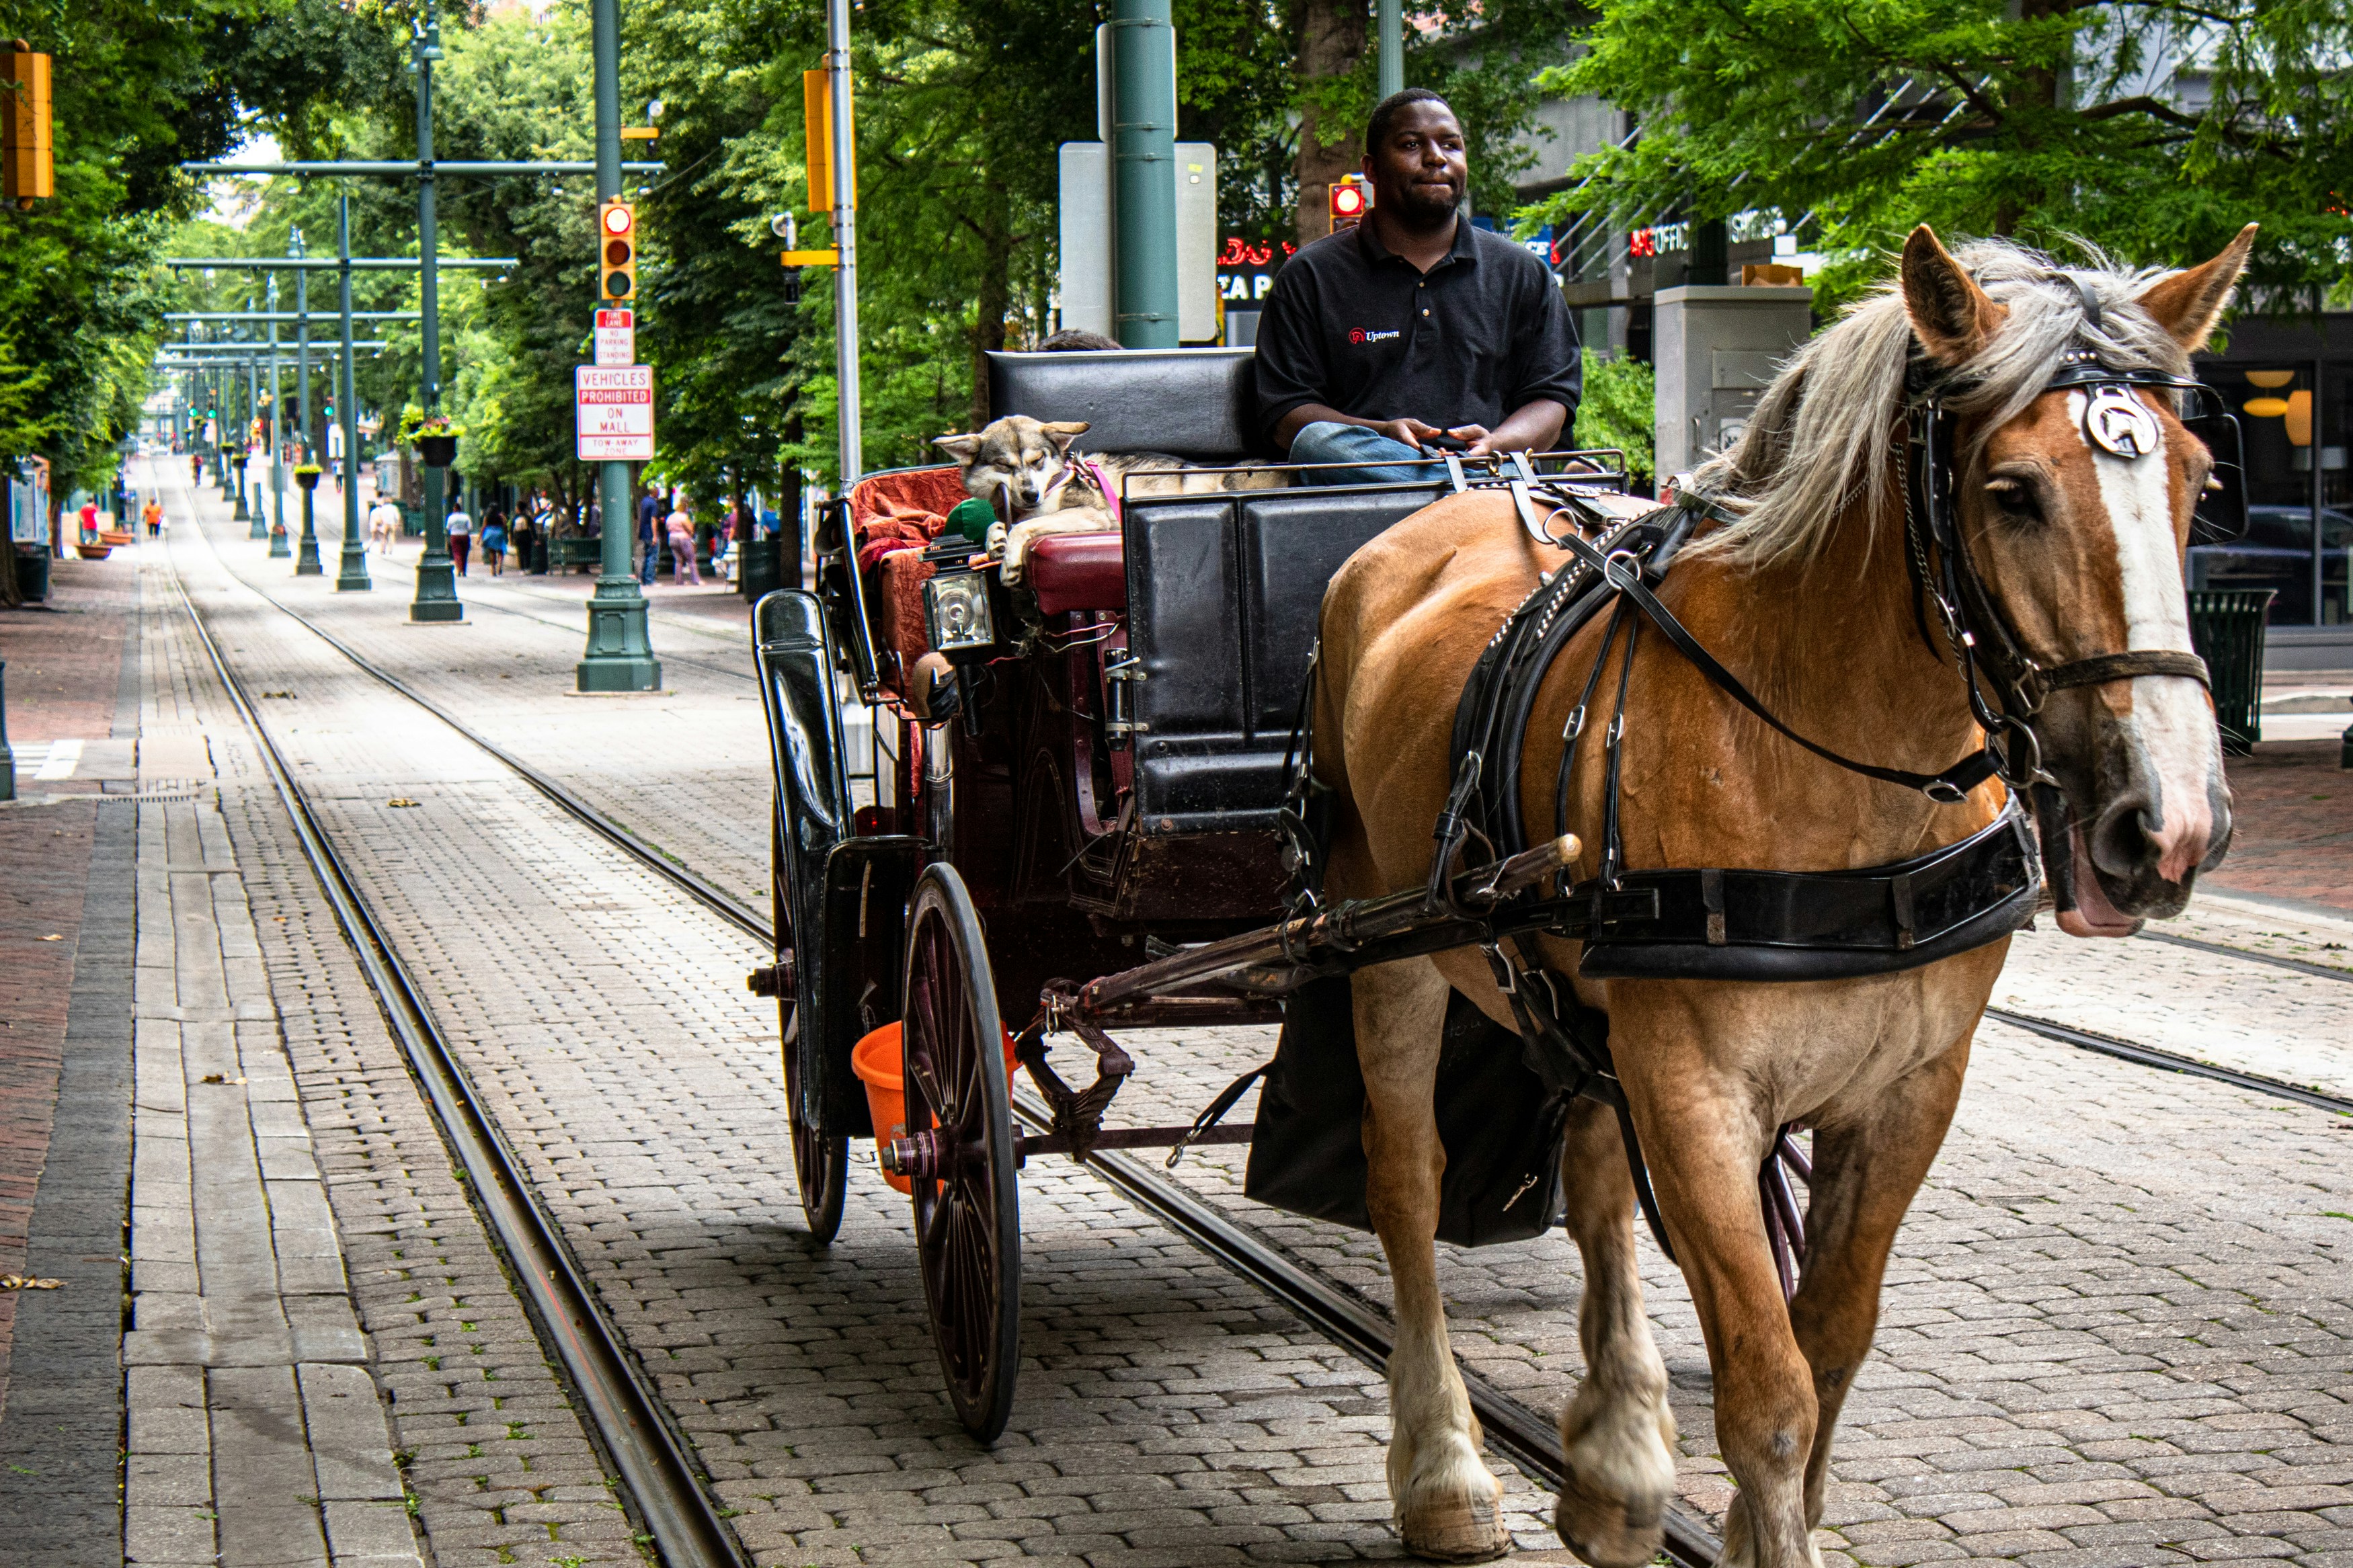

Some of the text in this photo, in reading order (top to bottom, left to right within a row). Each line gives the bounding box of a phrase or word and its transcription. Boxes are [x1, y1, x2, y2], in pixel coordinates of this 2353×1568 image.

[606, 311, 621, 319] FIRE
[605, 319, 622, 327] LANE
[1365, 330, 1400, 343] Uptown
[582, 373, 646, 386] VEHICLES
[581, 390, 646, 403] PROHIBITED
[607, 407, 623, 419] ON
[600, 422, 630, 433] MALL
